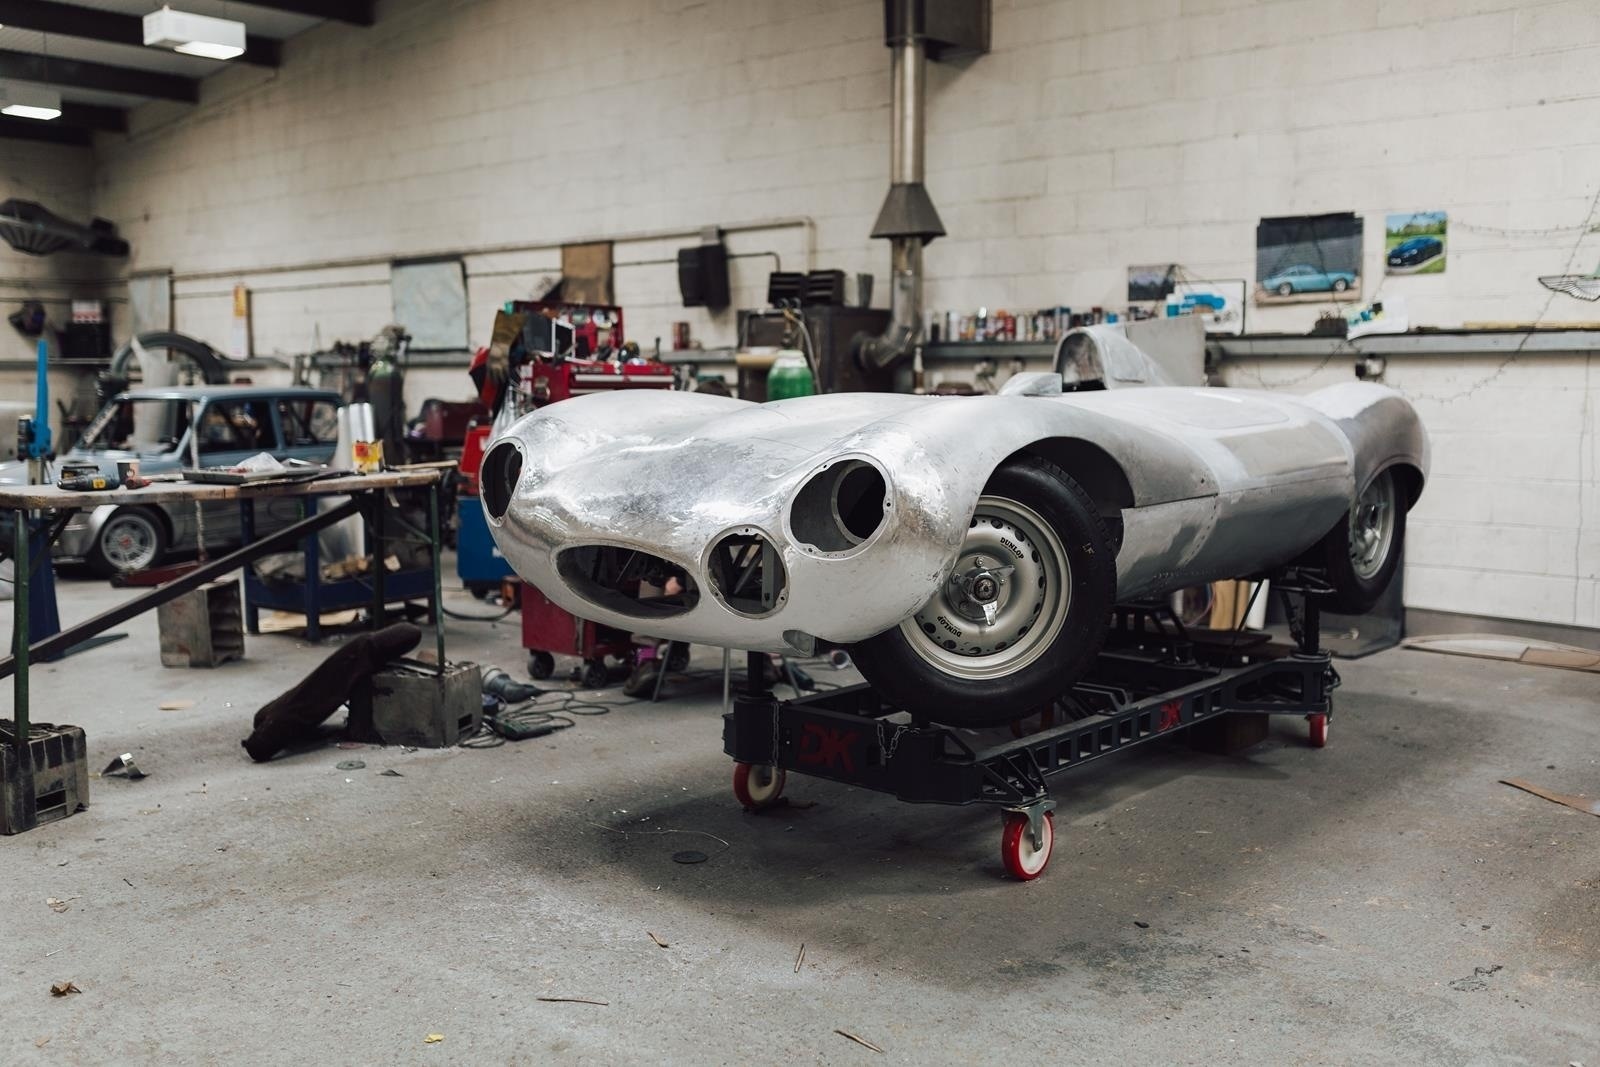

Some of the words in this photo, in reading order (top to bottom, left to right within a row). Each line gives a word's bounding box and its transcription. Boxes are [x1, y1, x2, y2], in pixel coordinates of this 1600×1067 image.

[1000, 537, 1024, 559] DUNLOP
[937, 616, 961, 637] DUNLOP
[1157, 699, 1183, 732] DK
[799, 722, 861, 773] DK
